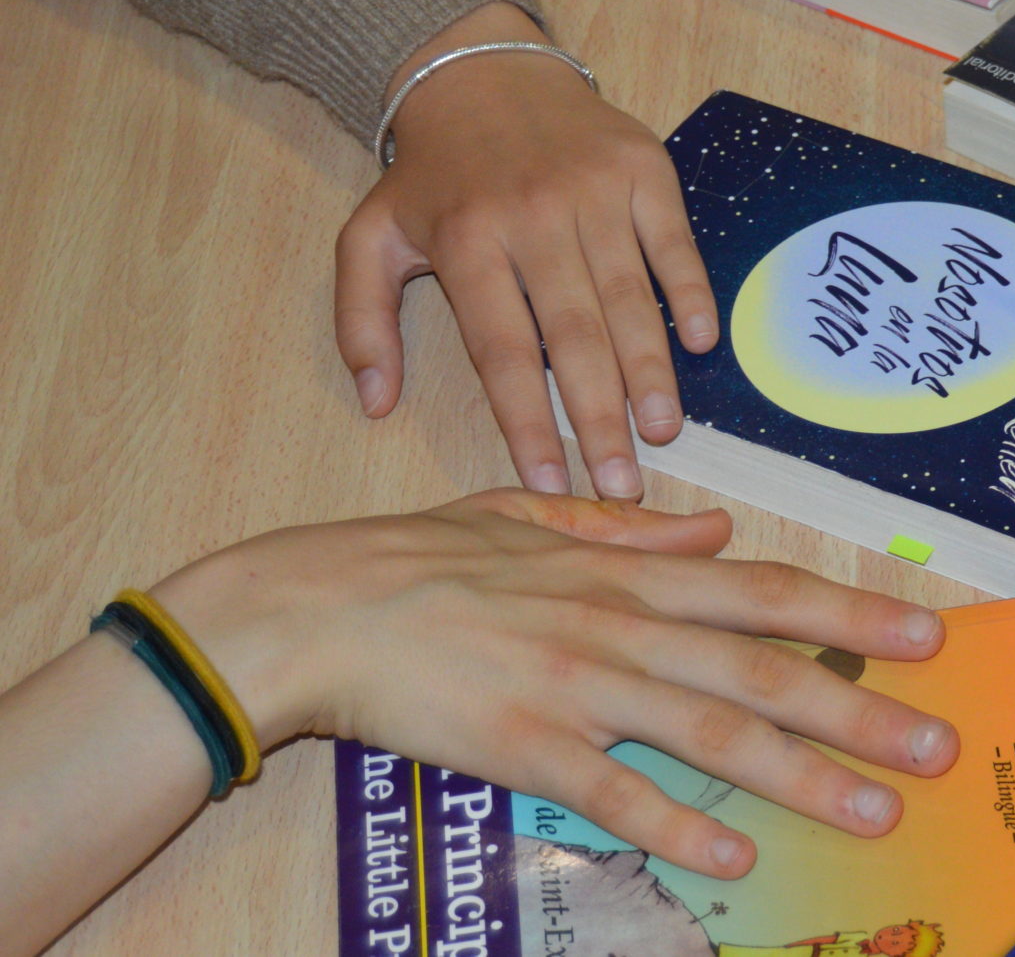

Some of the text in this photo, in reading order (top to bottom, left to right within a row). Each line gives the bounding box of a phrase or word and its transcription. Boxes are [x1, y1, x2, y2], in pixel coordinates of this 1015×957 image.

[808, 230, 919, 358] Luna
[870, 303, 915, 375] en la
[911, 226, 1012, 399] Nosotros
[363, 752, 402, 801] he
[534, 806, 567, 836] de
[365, 805, 409, 919] Little
